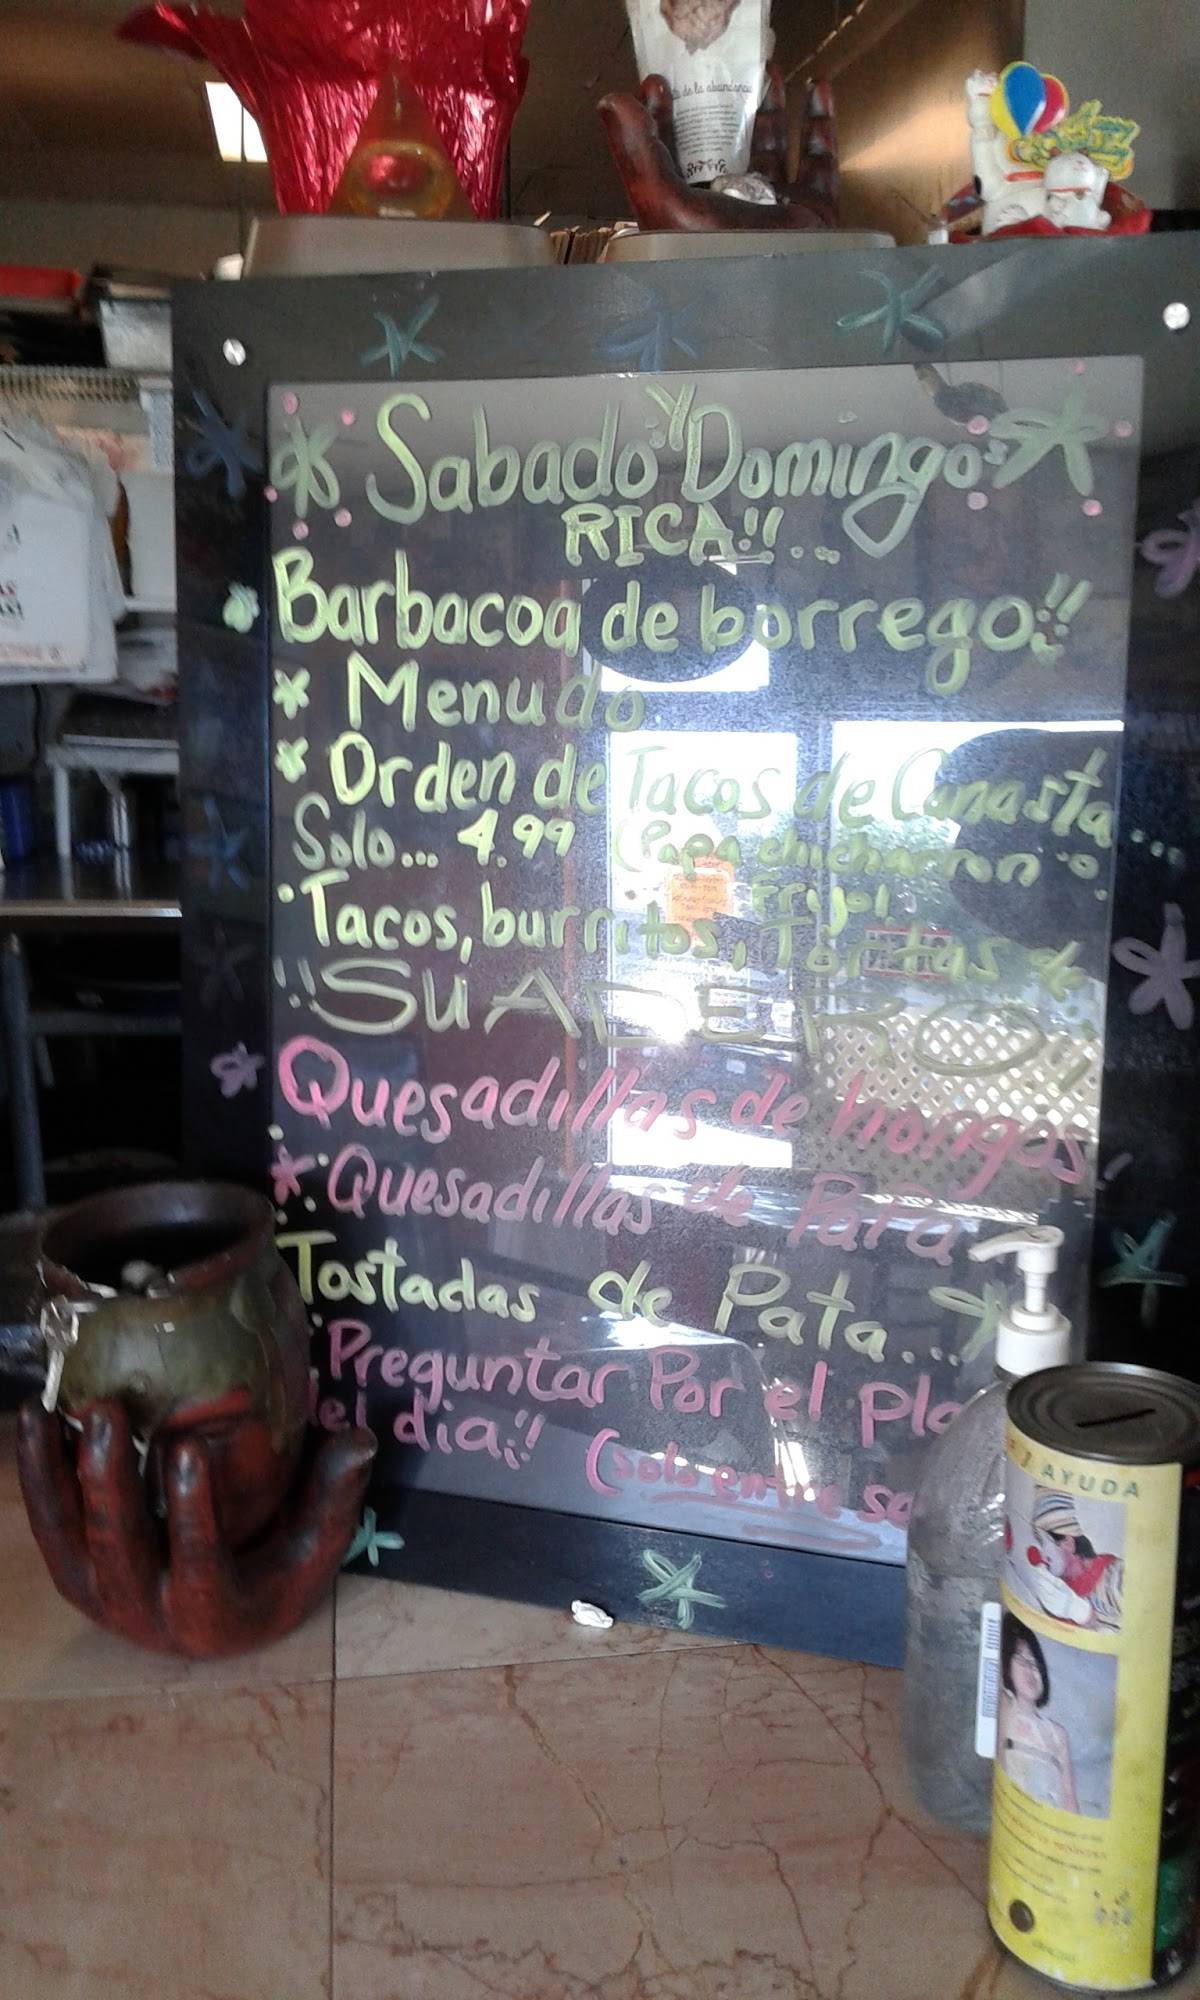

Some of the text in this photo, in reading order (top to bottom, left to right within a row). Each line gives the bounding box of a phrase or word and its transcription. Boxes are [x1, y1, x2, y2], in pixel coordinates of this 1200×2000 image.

[365, 393, 658, 524] Sabado
[273, 547, 581, 657] Barbacoa
[601, 580, 680, 653] de
[347, 651, 644, 732] Menudo
[329, 731, 516, 814] Orden
[533, 743, 607, 814] de
[627, 744, 779, 819] Tacos
[794, 752, 876, 829] de
[457, 808, 576, 867] 4.99
[278, 1035, 716, 1143] Quesadillas
[730, 1068, 808, 1135] de
[327, 1143, 666, 1236] Quesadillas
[683, 1163, 753, 1227] de
[275, 1230, 540, 1322] Tostadas
[588, 1260, 673, 1327] de
[327, 1318, 630, 1412] Preguntar
[764, 1361, 827, 1420] el
[1040, 1462, 1141, 1498] AYUDA
